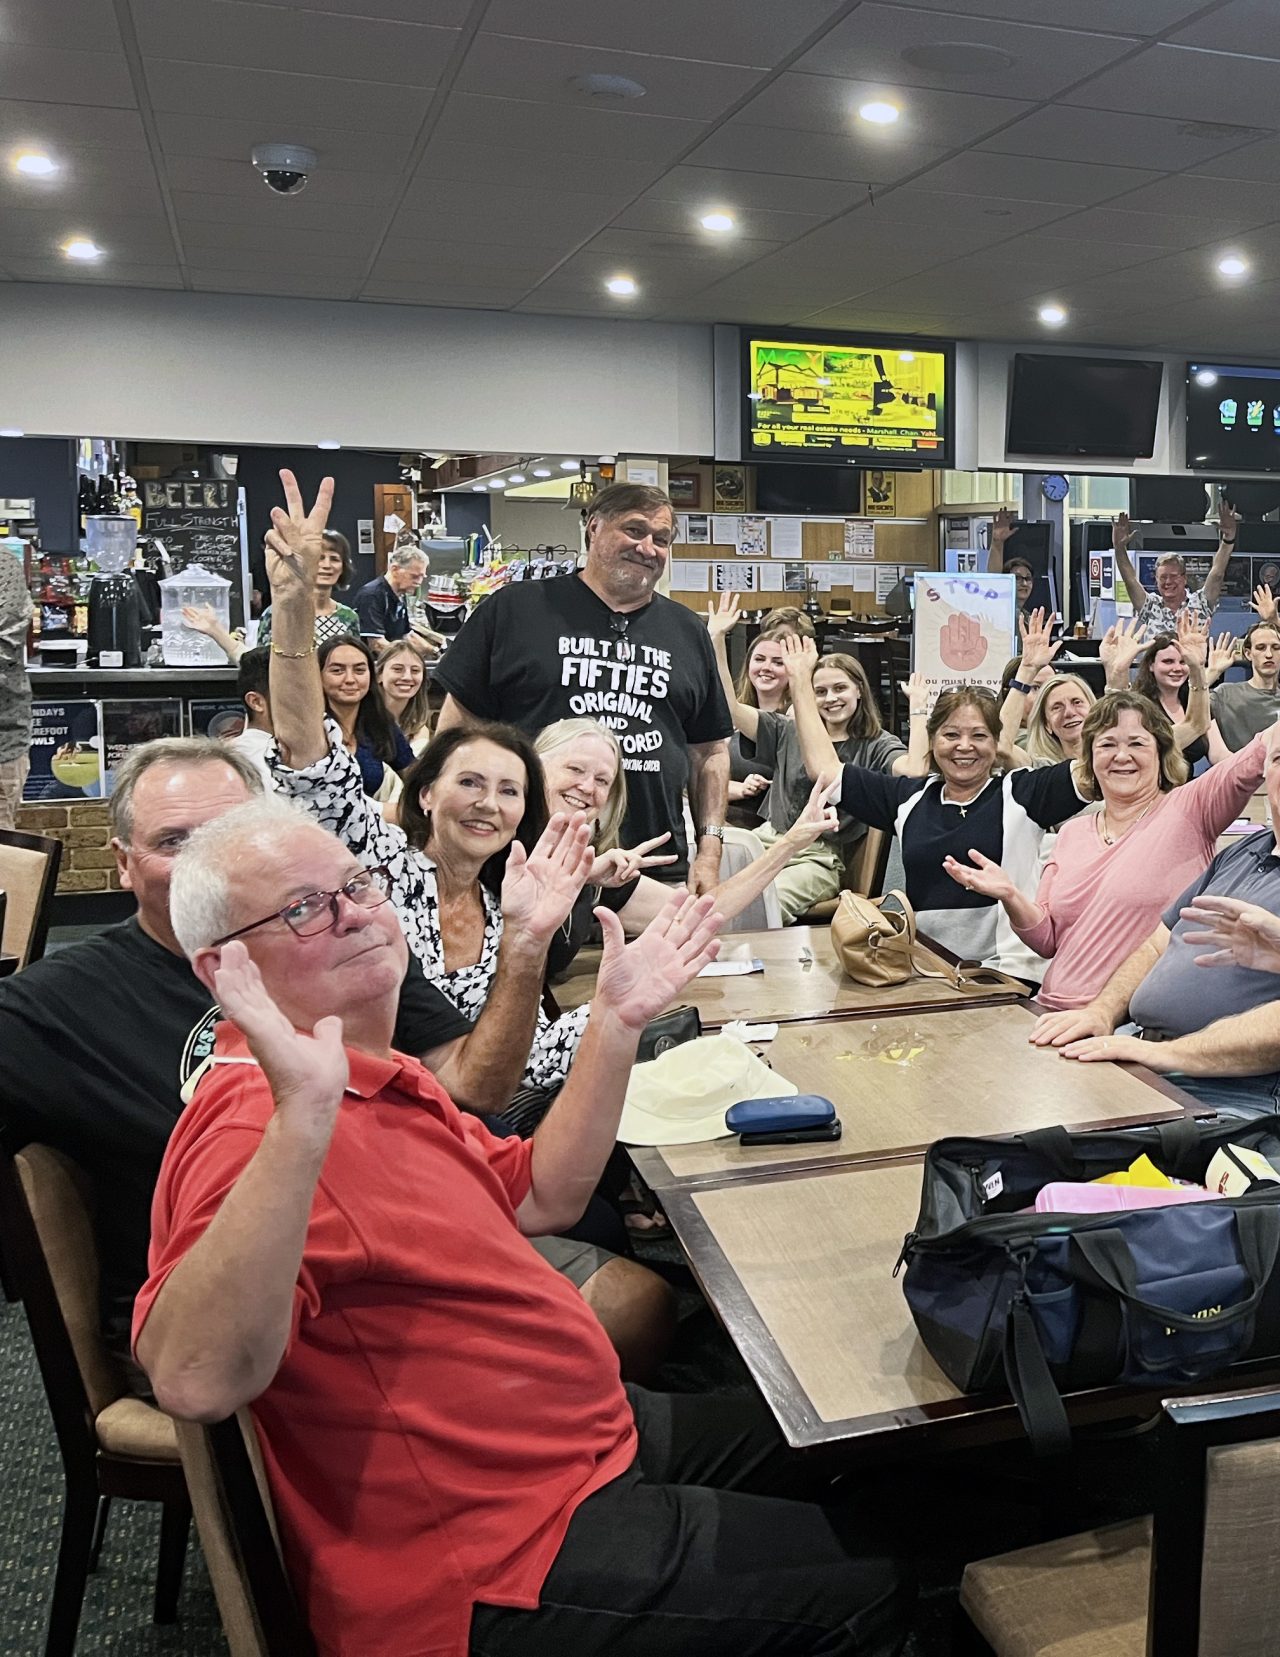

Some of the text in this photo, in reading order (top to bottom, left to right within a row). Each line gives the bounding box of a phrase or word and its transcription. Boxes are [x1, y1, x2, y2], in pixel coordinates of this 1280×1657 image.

[144, 482, 229, 509] BEER!
[926, 578, 999, 602] STOP
[558, 636, 613, 658] BUILT
[640, 645, 673, 670] THE
[561, 656, 670, 698] FIFTIES
[941, 677, 967, 685] must
[970, 677, 983, 685] be
[32, 707, 65, 717] NDAYS
[569, 690, 653, 724] ORIGINAL
[597, 715, 629, 730] AND
[614, 730, 663, 754] TORED
